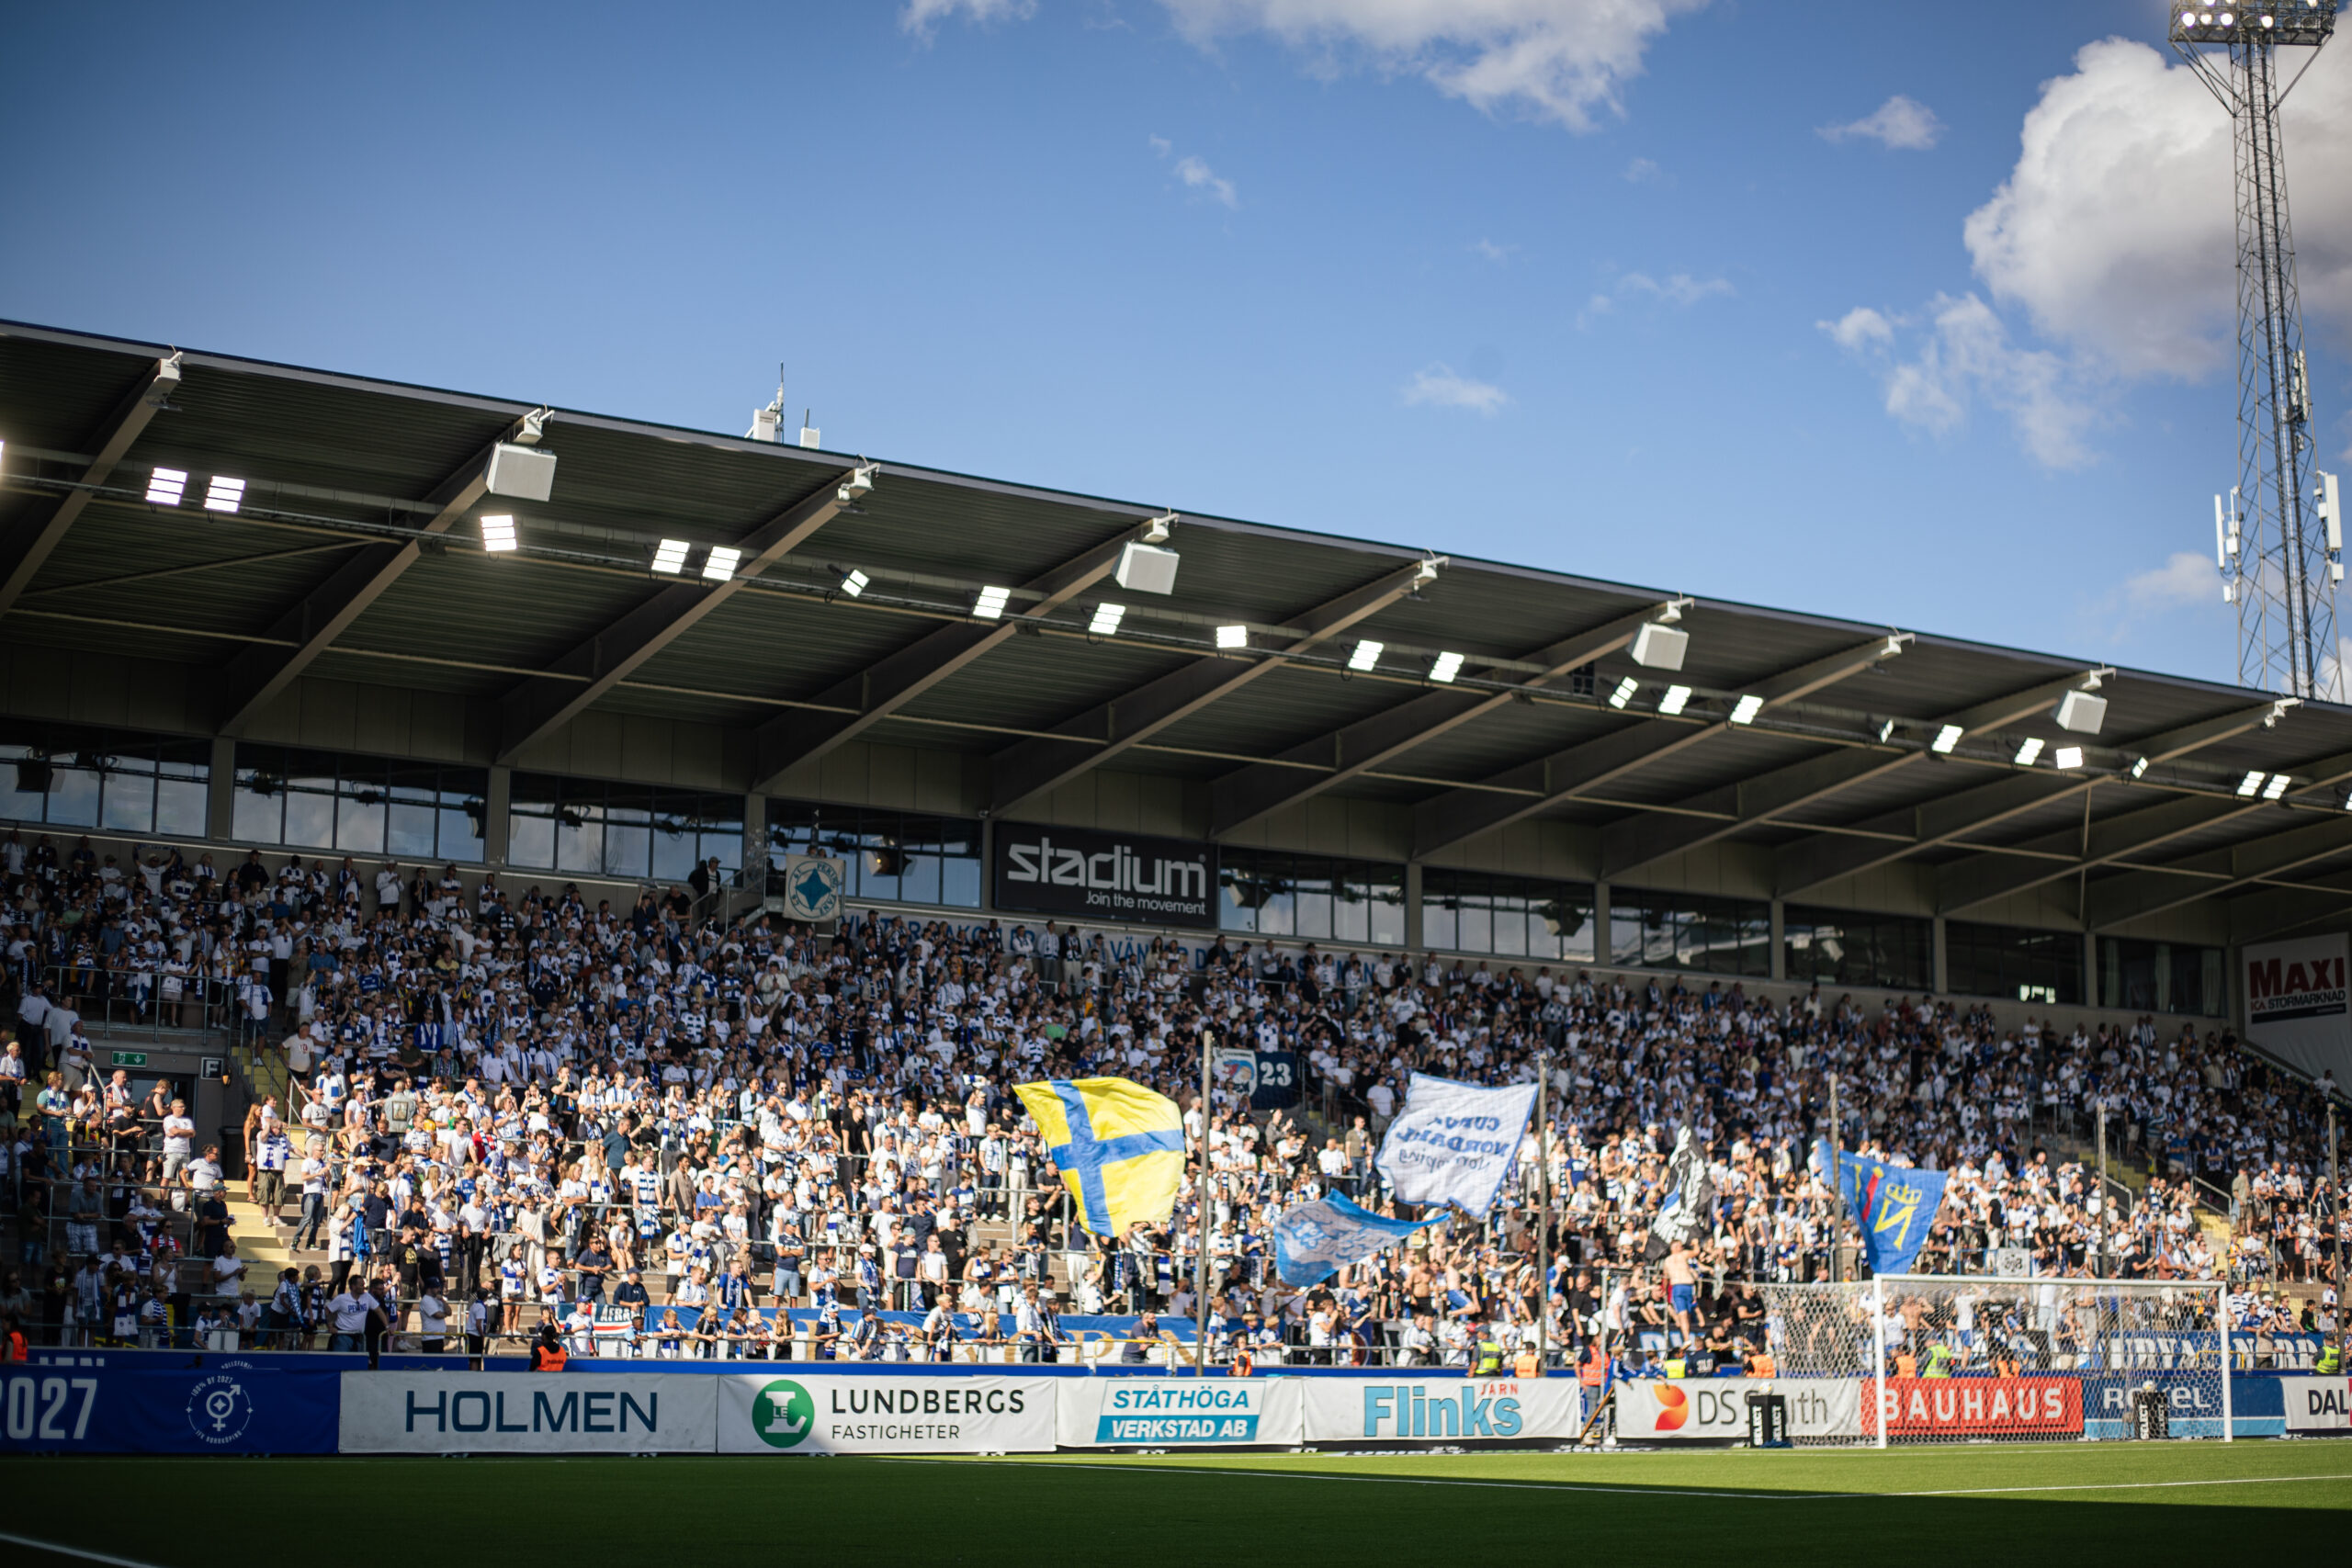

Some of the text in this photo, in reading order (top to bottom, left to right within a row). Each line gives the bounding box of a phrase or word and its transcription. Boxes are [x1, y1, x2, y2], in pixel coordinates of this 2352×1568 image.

[1007, 835, 1206, 899] stadium
[1085, 890, 1206, 917] Join the movement
[2248, 957, 2346, 998] MAXI
[2267, 990, 2346, 1010] STORMARKNAD
[205, 1060, 220, 1077] F
[1259, 1061, 1293, 1087] 23
[217, 1375, 233, 1384] 2027
[0, 1376, 97, 1440] 027
[831, 1389, 1024, 1414] LUNDBERGS
[1113, 1383, 1249, 1409] STÅTHÖGA
[1698, 1388, 1828, 1426] DS ith
[1885, 1386, 2063, 1421] BAUHAUS
[2308, 1389, 2349, 1416] DAL
[406, 1390, 657, 1433] HOLMEN
[1363, 1385, 1523, 1438] Flinks
[1751, 1404, 1764, 1446] SELECT
[2138, 1403, 2150, 1440] SELECT
[831, 1424, 959, 1440] FASTIGHETER
[1112, 1416, 1249, 1439] VERKSTAD AB
